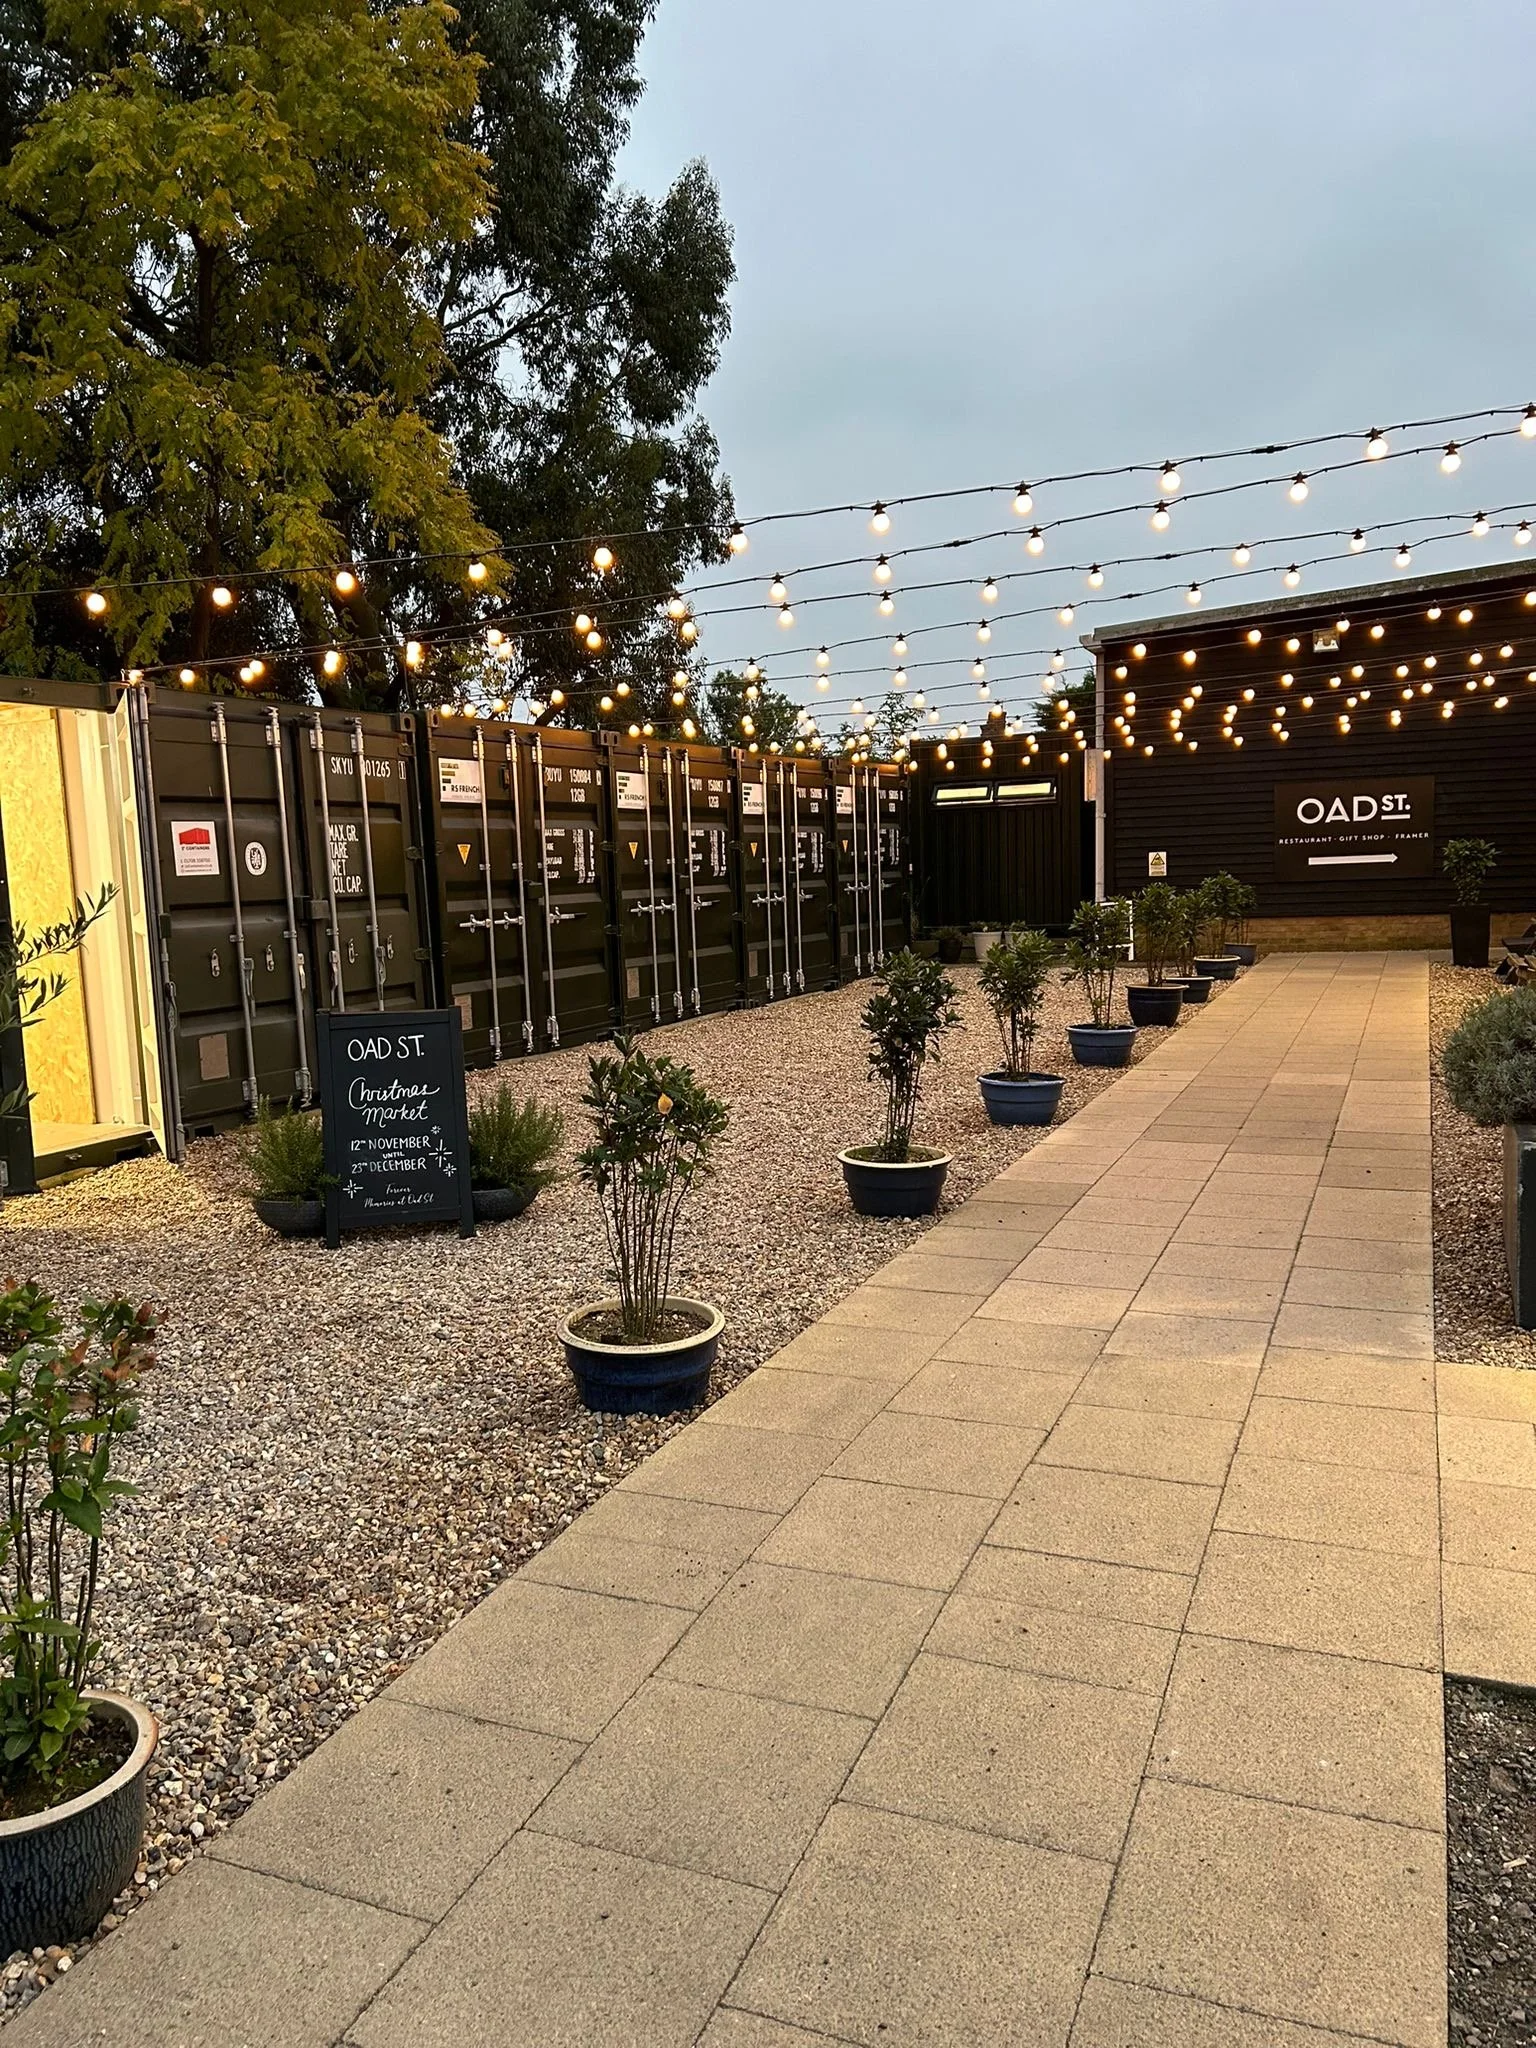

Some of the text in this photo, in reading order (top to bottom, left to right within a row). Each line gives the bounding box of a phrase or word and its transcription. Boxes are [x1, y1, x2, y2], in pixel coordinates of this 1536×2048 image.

[331, 756, 354, 775] SKYU
[451, 784, 459, 792] RS
[1297, 794, 1411, 824] OAD ST.
[1278, 836, 1332, 845] RESTAURANT
[1339, 834, 1359, 842] GIFT
[1395, 832, 1429, 840] FRAMER
[330, 842, 348, 859] TARE
[331, 859, 347, 876] NET
[347, 1034, 425, 1061] OAD ST.
[348, 1076, 440, 1110] Christmas
[368, 1135, 431, 1150] NOVEMBER
[382, 1151, 406, 1159] UNTIL
[369, 1157, 427, 1173] DECEMBER
[364, 1197, 395, 1208] Memories
